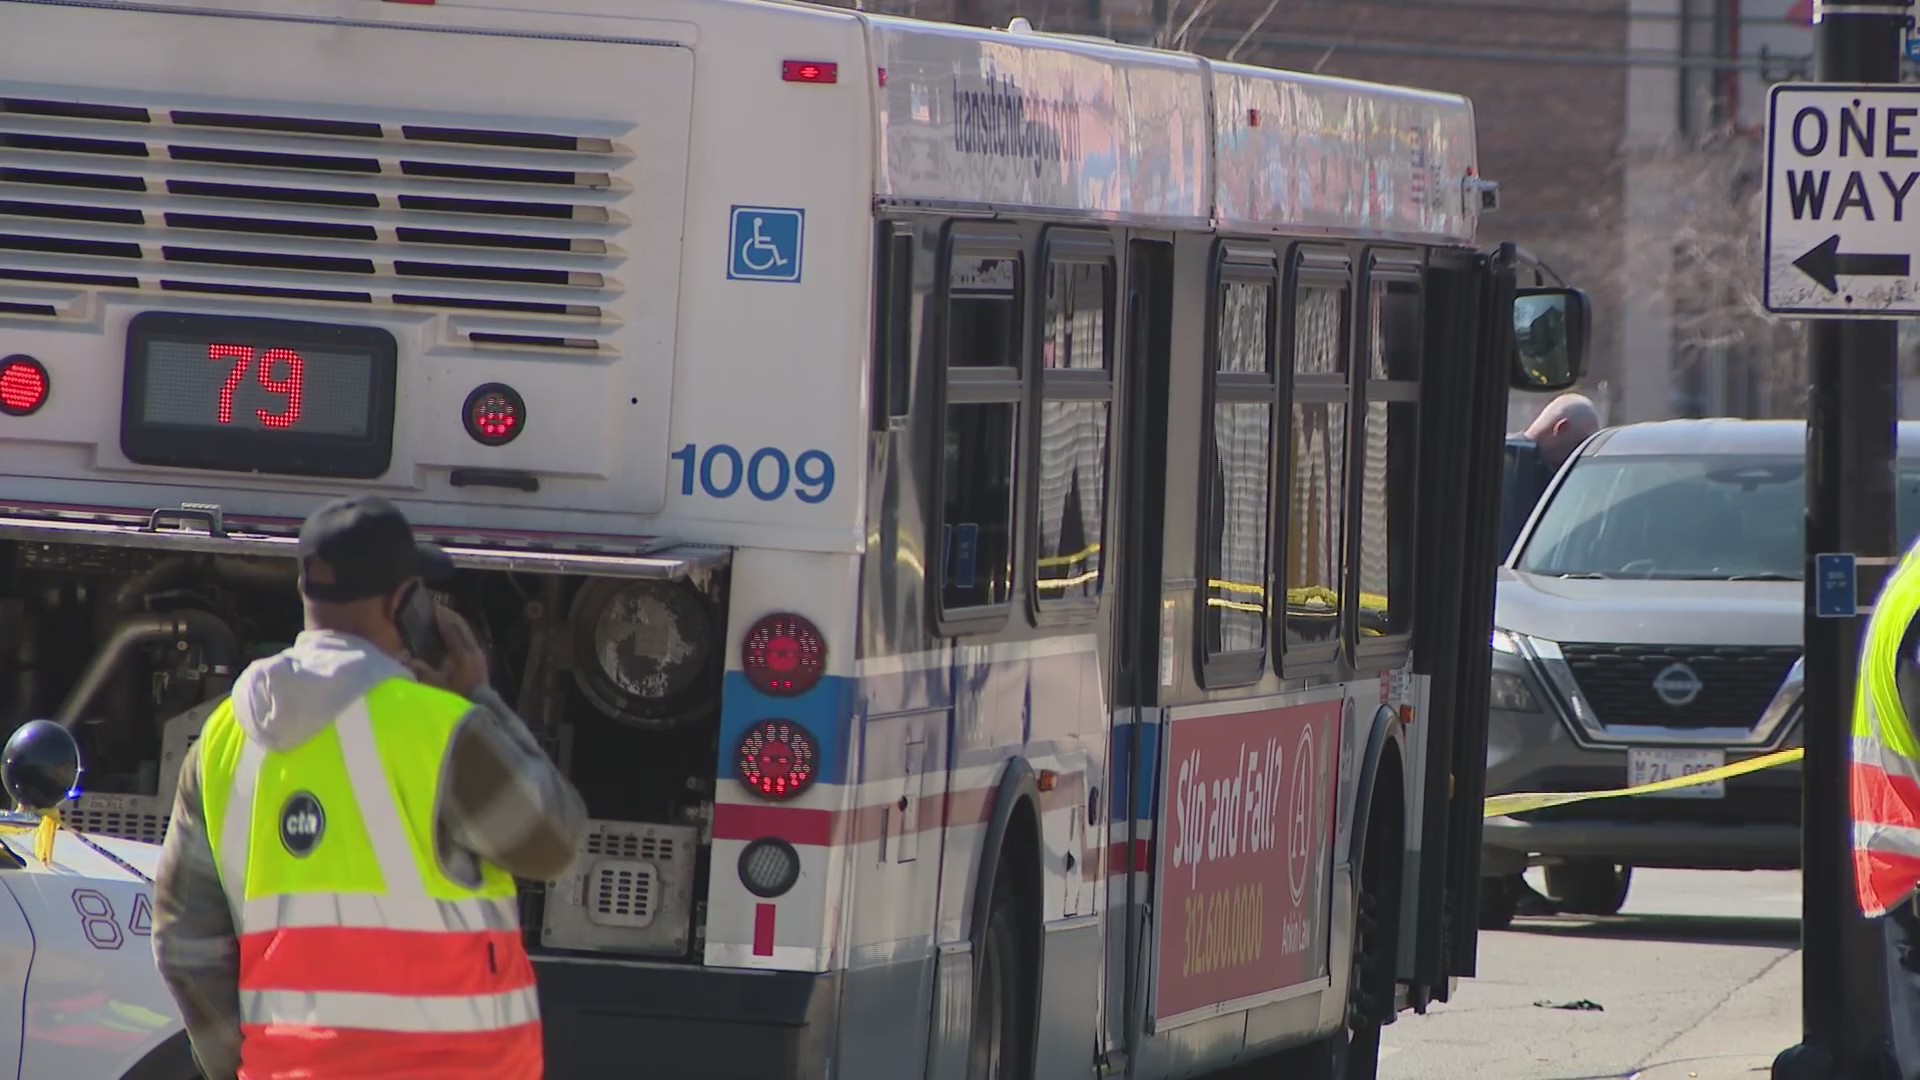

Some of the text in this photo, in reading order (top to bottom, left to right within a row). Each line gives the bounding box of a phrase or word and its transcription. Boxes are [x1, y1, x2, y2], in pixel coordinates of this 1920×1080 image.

[953, 71, 1081, 178] transitchicago.com
[1793, 106, 1918, 158] ONE
[1786, 170, 1920, 221] WAY
[208, 344, 303, 427] 79
[671, 443, 835, 504] 1009
[1173, 737, 1282, 890] Slip and Fall?
[1183, 882, 1264, 977] 312.600.0000
